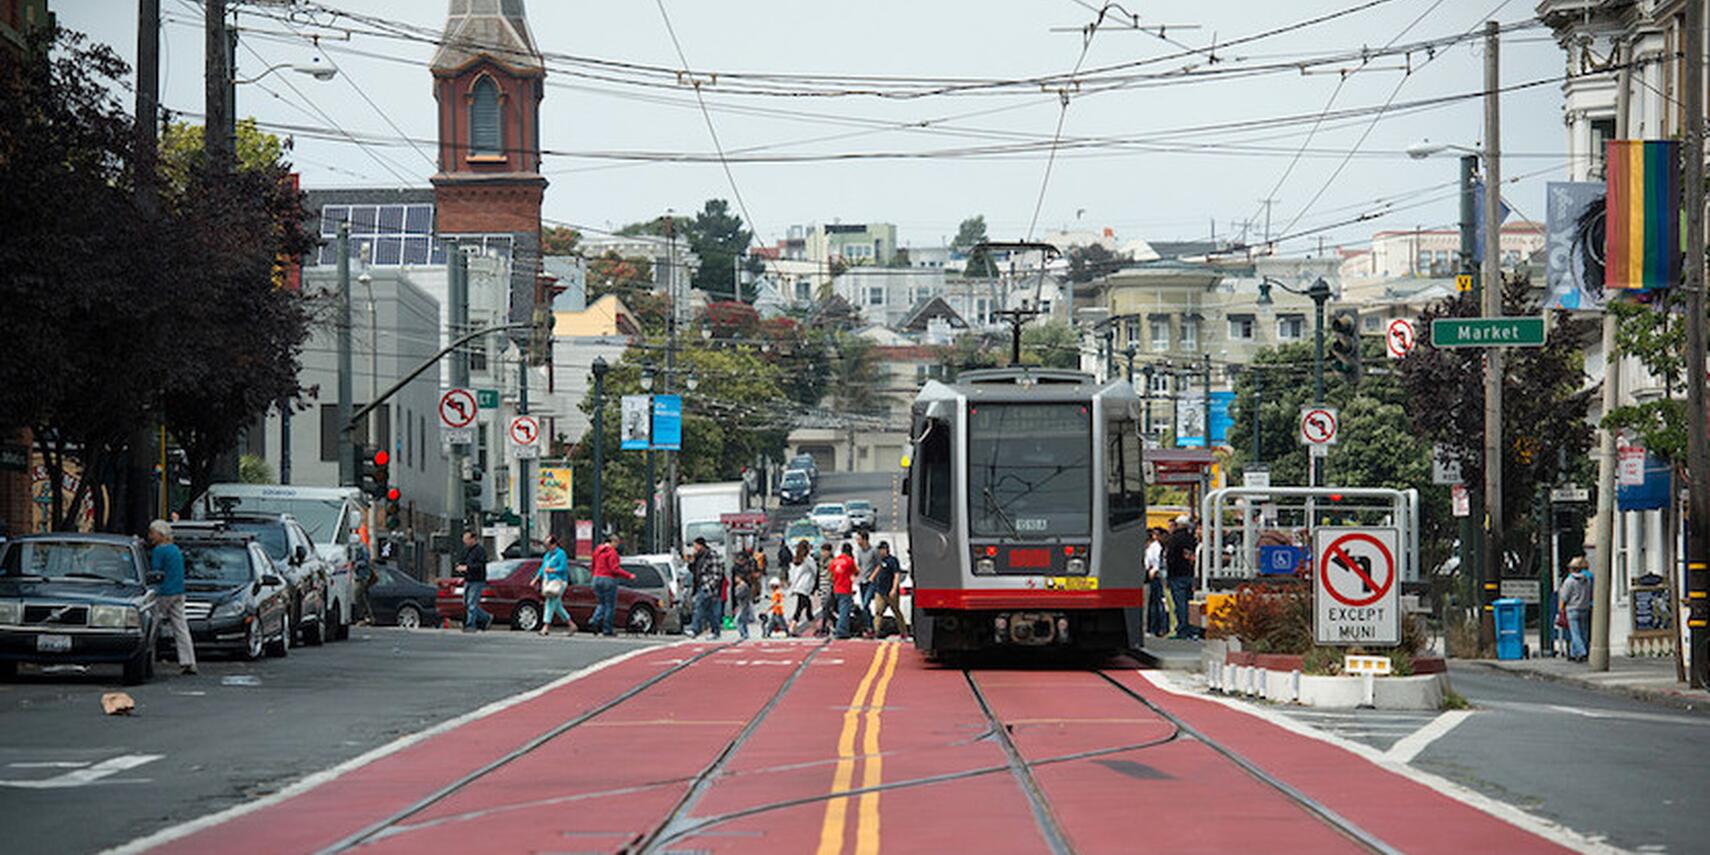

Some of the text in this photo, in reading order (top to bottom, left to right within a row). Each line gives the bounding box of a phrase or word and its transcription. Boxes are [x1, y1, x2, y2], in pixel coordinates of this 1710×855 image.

[1458, 278, 1469, 290] V
[1457, 325, 1520, 340] Market
[1328, 607, 1384, 622] EXCEPT
[1339, 625, 1376, 639] MUNI
